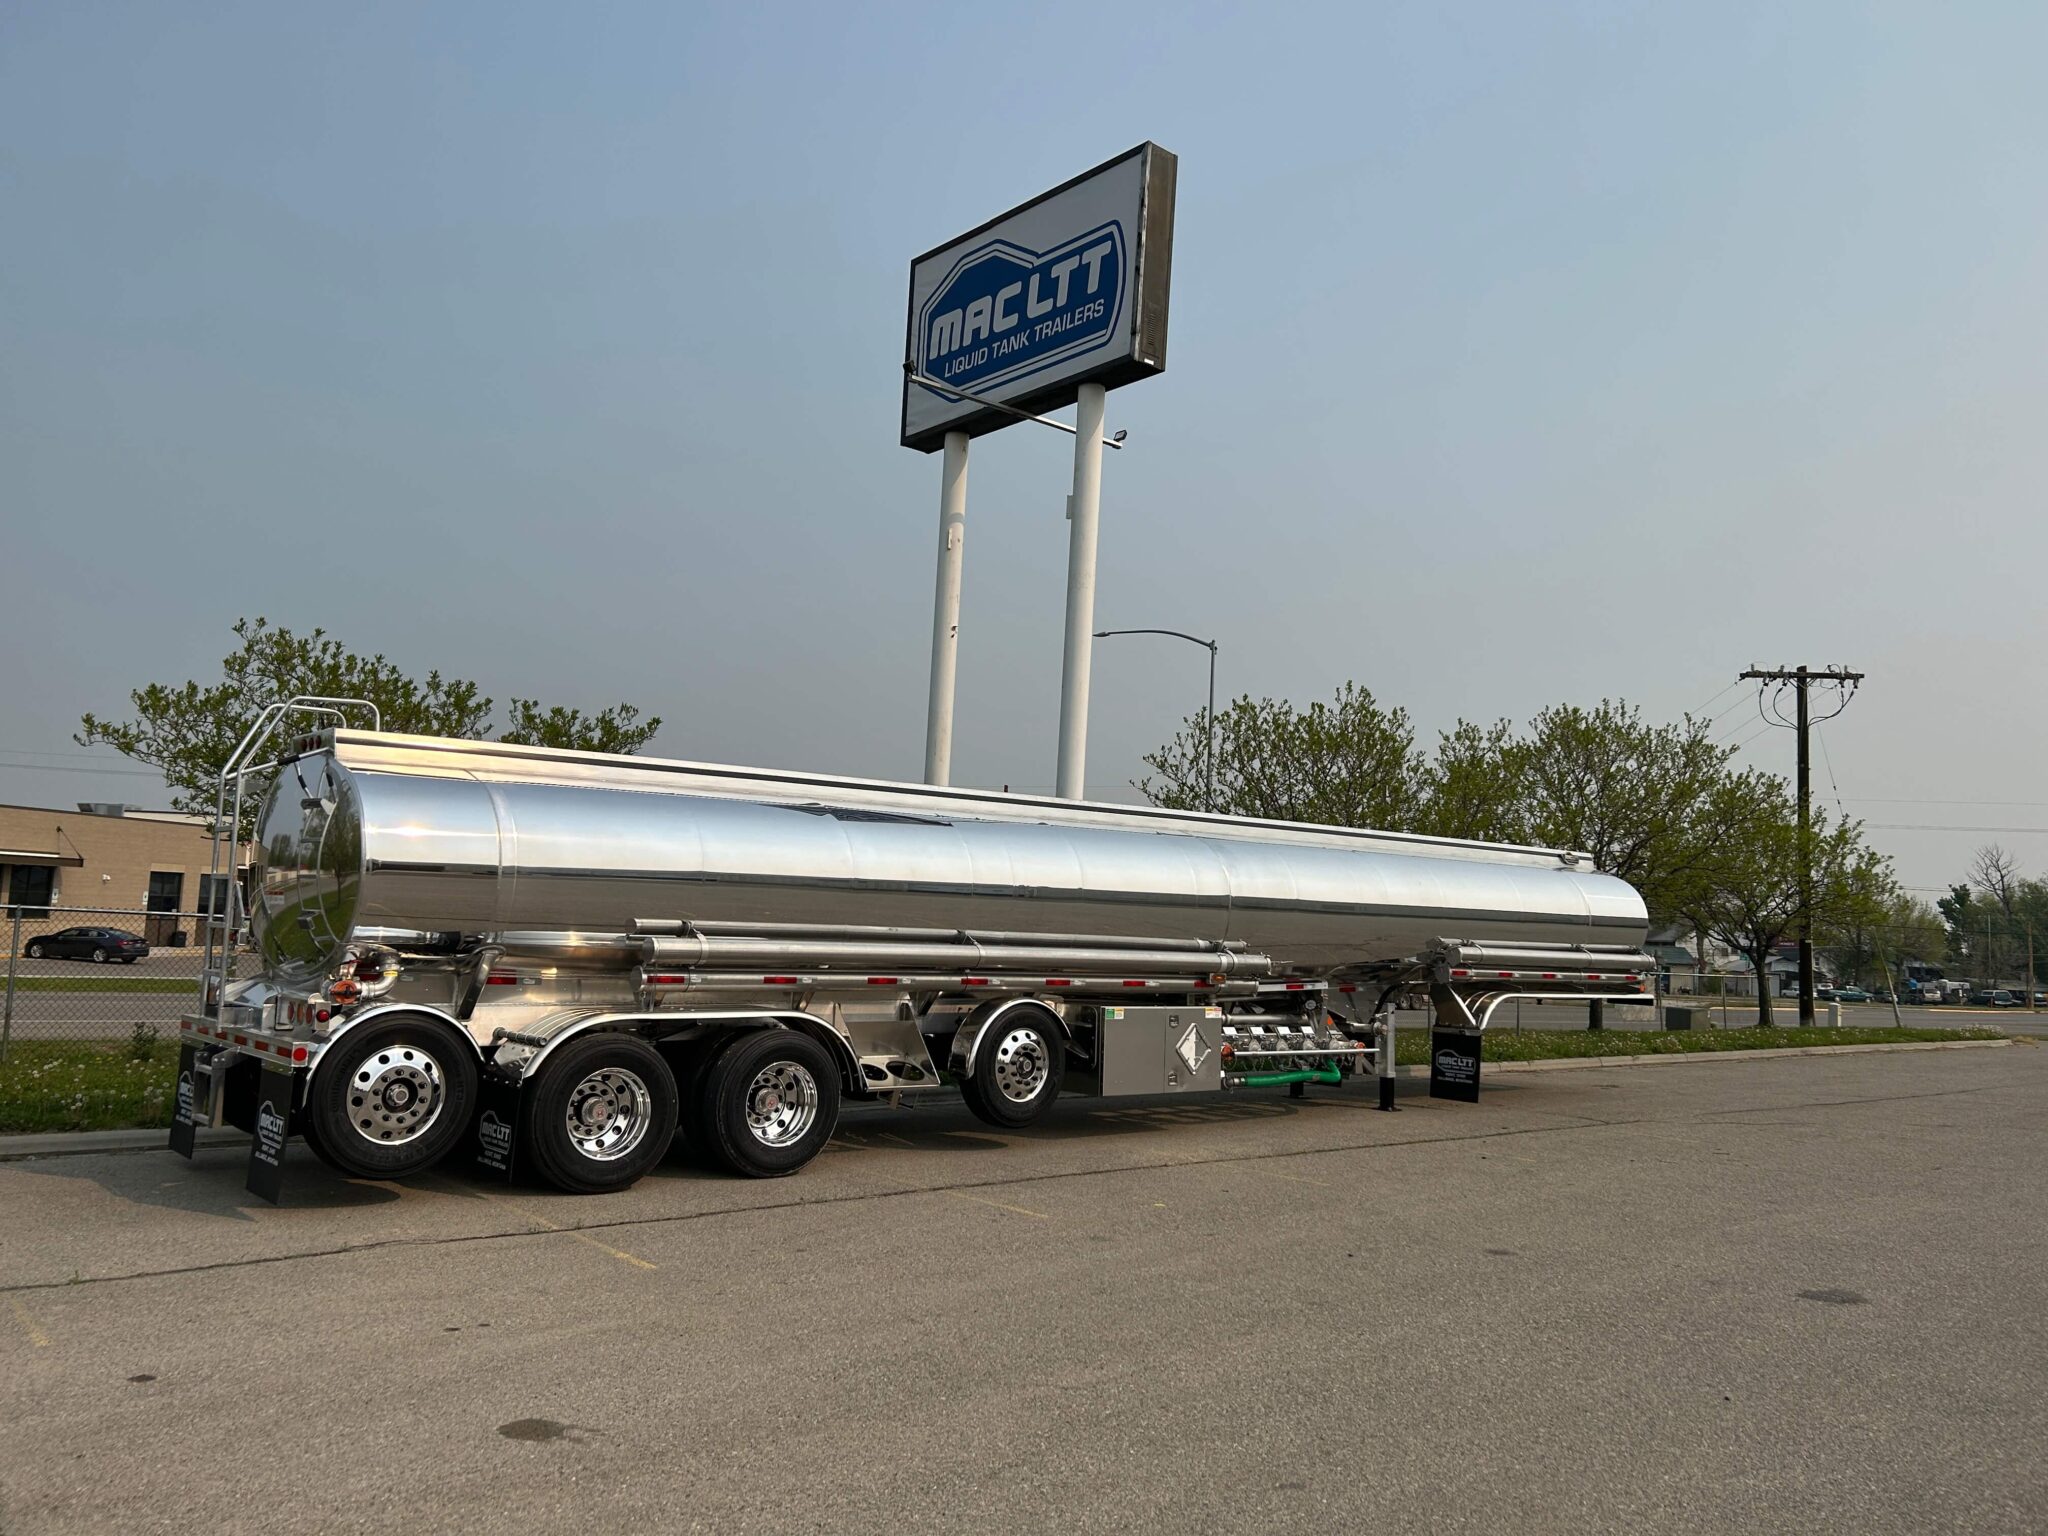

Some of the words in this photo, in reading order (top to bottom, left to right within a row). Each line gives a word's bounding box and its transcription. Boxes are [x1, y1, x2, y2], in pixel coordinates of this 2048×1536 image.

[929, 281, 1022, 360] MAC
[1026, 240, 1112, 319] LTT
[944, 347, 987, 378] LIQUID
[992, 329, 1030, 359] TANK
[1034, 299, 1105, 342] TRAILERS
